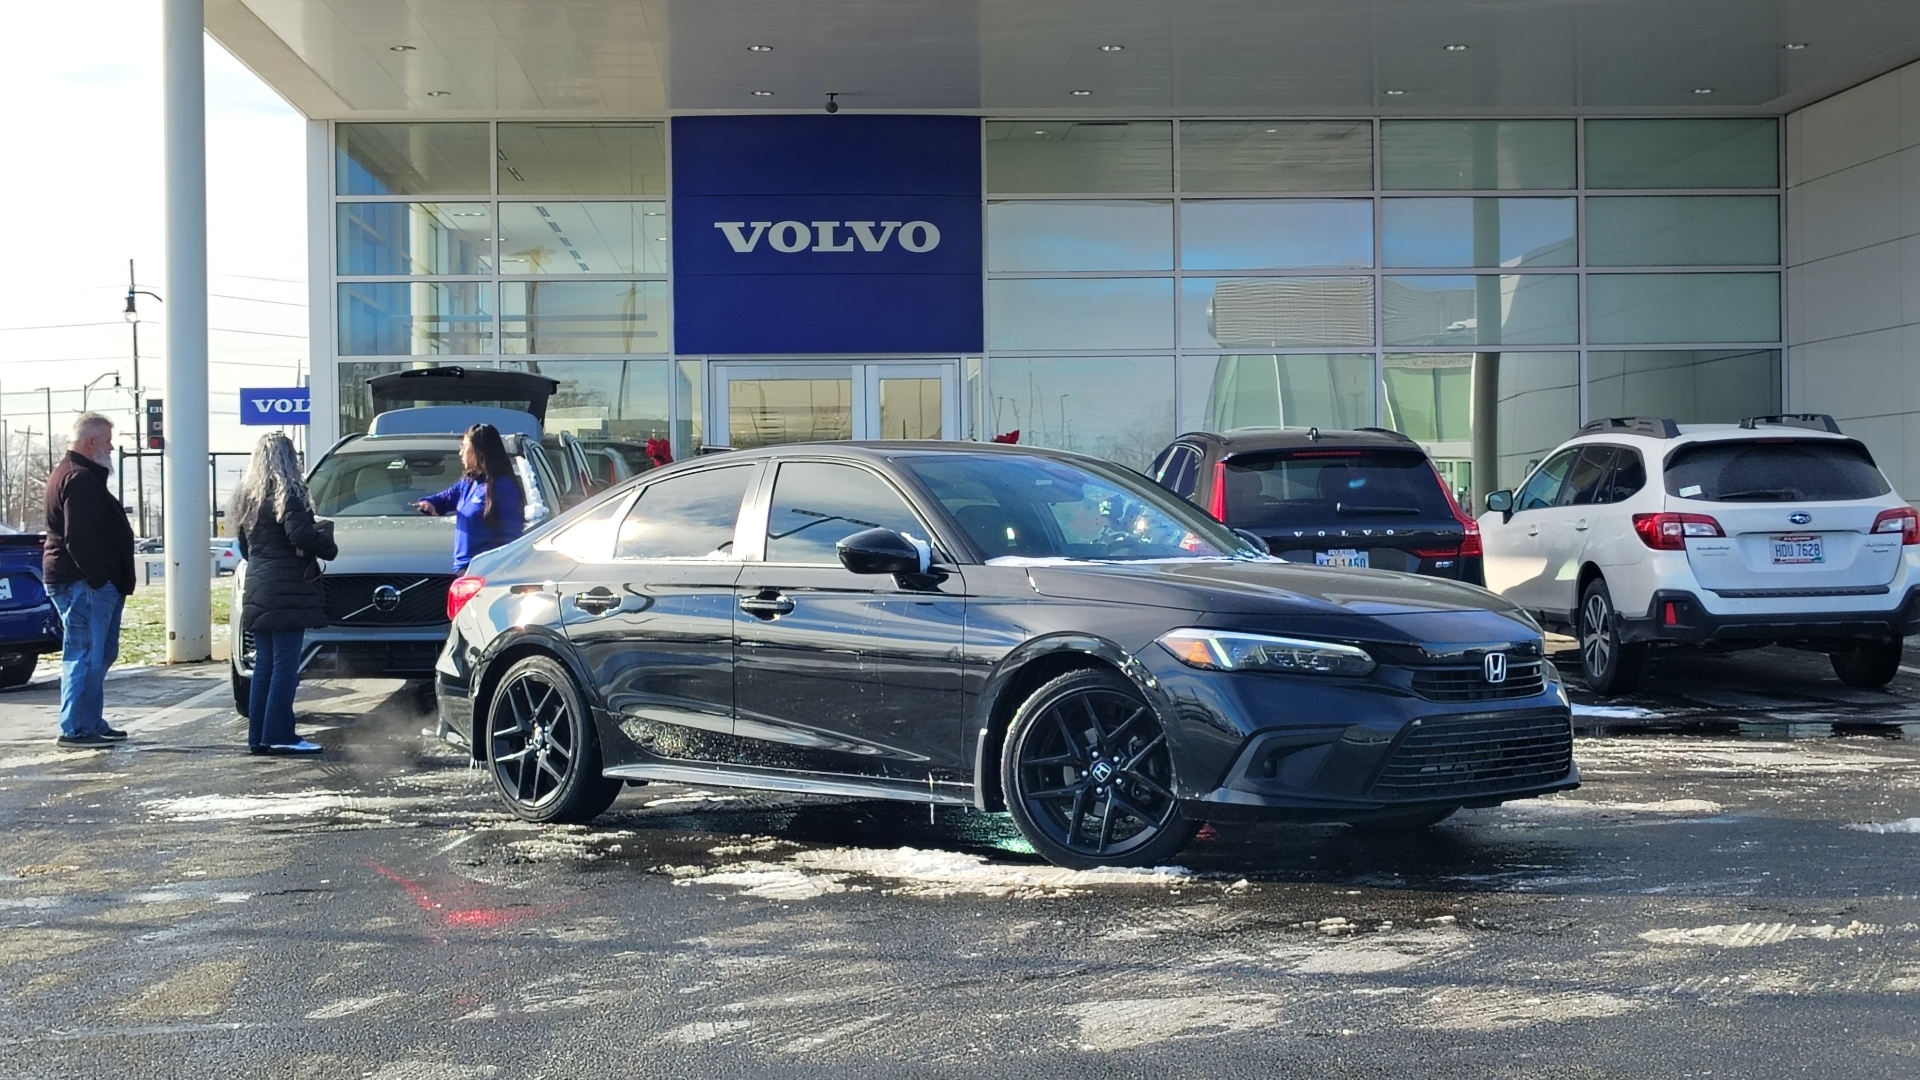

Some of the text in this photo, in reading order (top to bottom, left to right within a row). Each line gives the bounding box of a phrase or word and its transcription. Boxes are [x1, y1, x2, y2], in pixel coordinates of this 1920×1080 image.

[714, 220, 941, 253] VOLVO
[251, 398, 310, 413] VOL
[1293, 529, 1394, 538] VOLVO
[1774, 543, 1820, 557] HDU 7628
